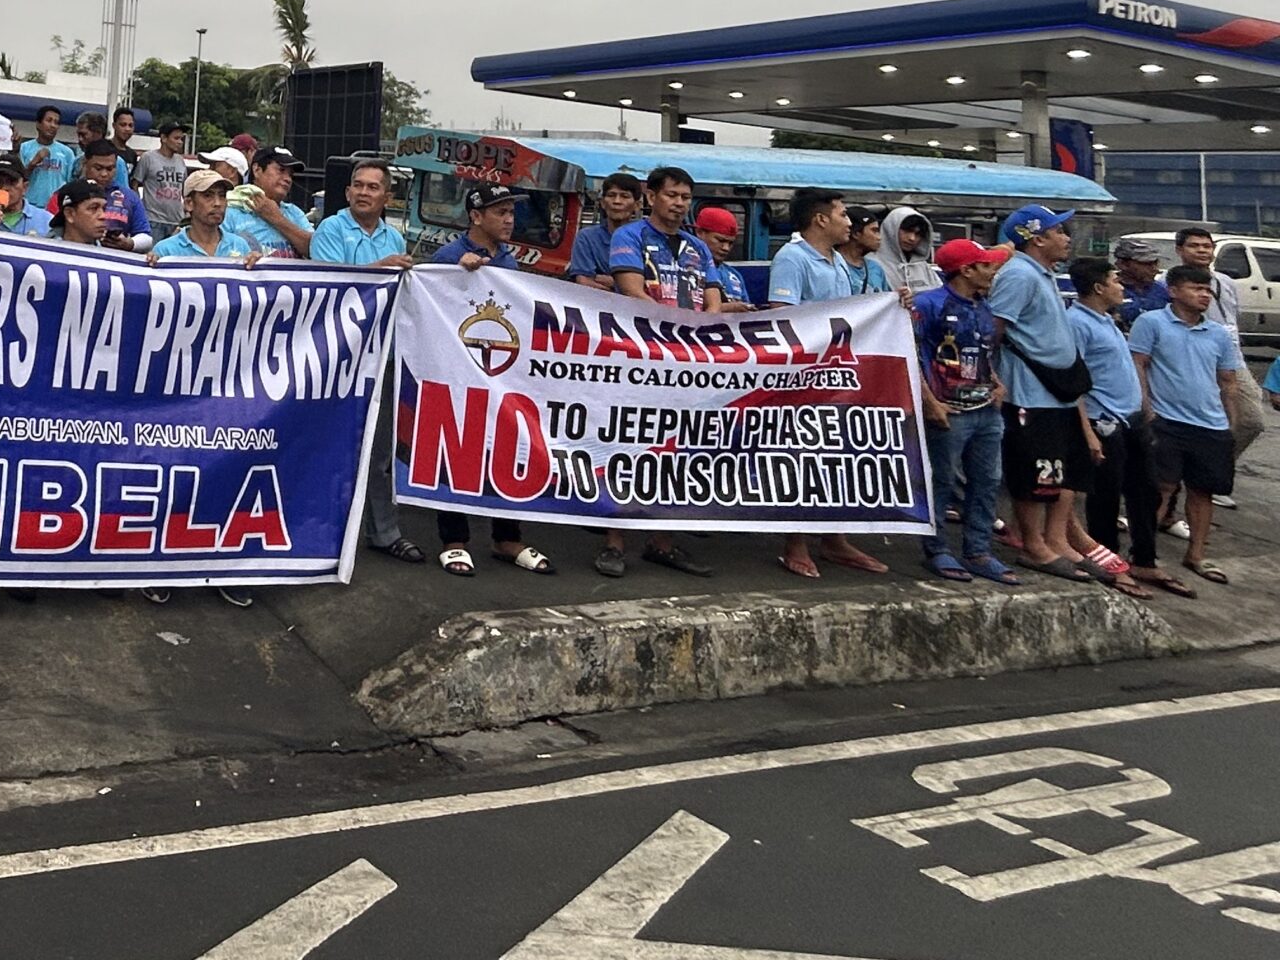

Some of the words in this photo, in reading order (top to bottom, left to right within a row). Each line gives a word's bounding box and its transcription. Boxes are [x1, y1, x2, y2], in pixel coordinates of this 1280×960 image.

[156, 170, 183, 183] SHE
[436, 135, 517, 175] HOPE
[52, 270, 125, 392] NA
[134, 278, 388, 401] PRANGKISA
[531, 300, 858, 365] MANIBELA
[529, 359, 621, 384] NORTH
[628, 367, 758, 389] CALOOCAN
[762, 367, 860, 391] CHAPTER
[134, 423, 278, 450] KAUNLARAN.
[408, 379, 553, 502] NO
[547, 401, 587, 440] TO
[597, 406, 738, 450] JEEPNEY
[742, 406, 841, 451] PHASE
[846, 407, 905, 451] OUT
[552, 448, 599, 502] TO
[606, 451, 914, 508] CONSOLIDATION
